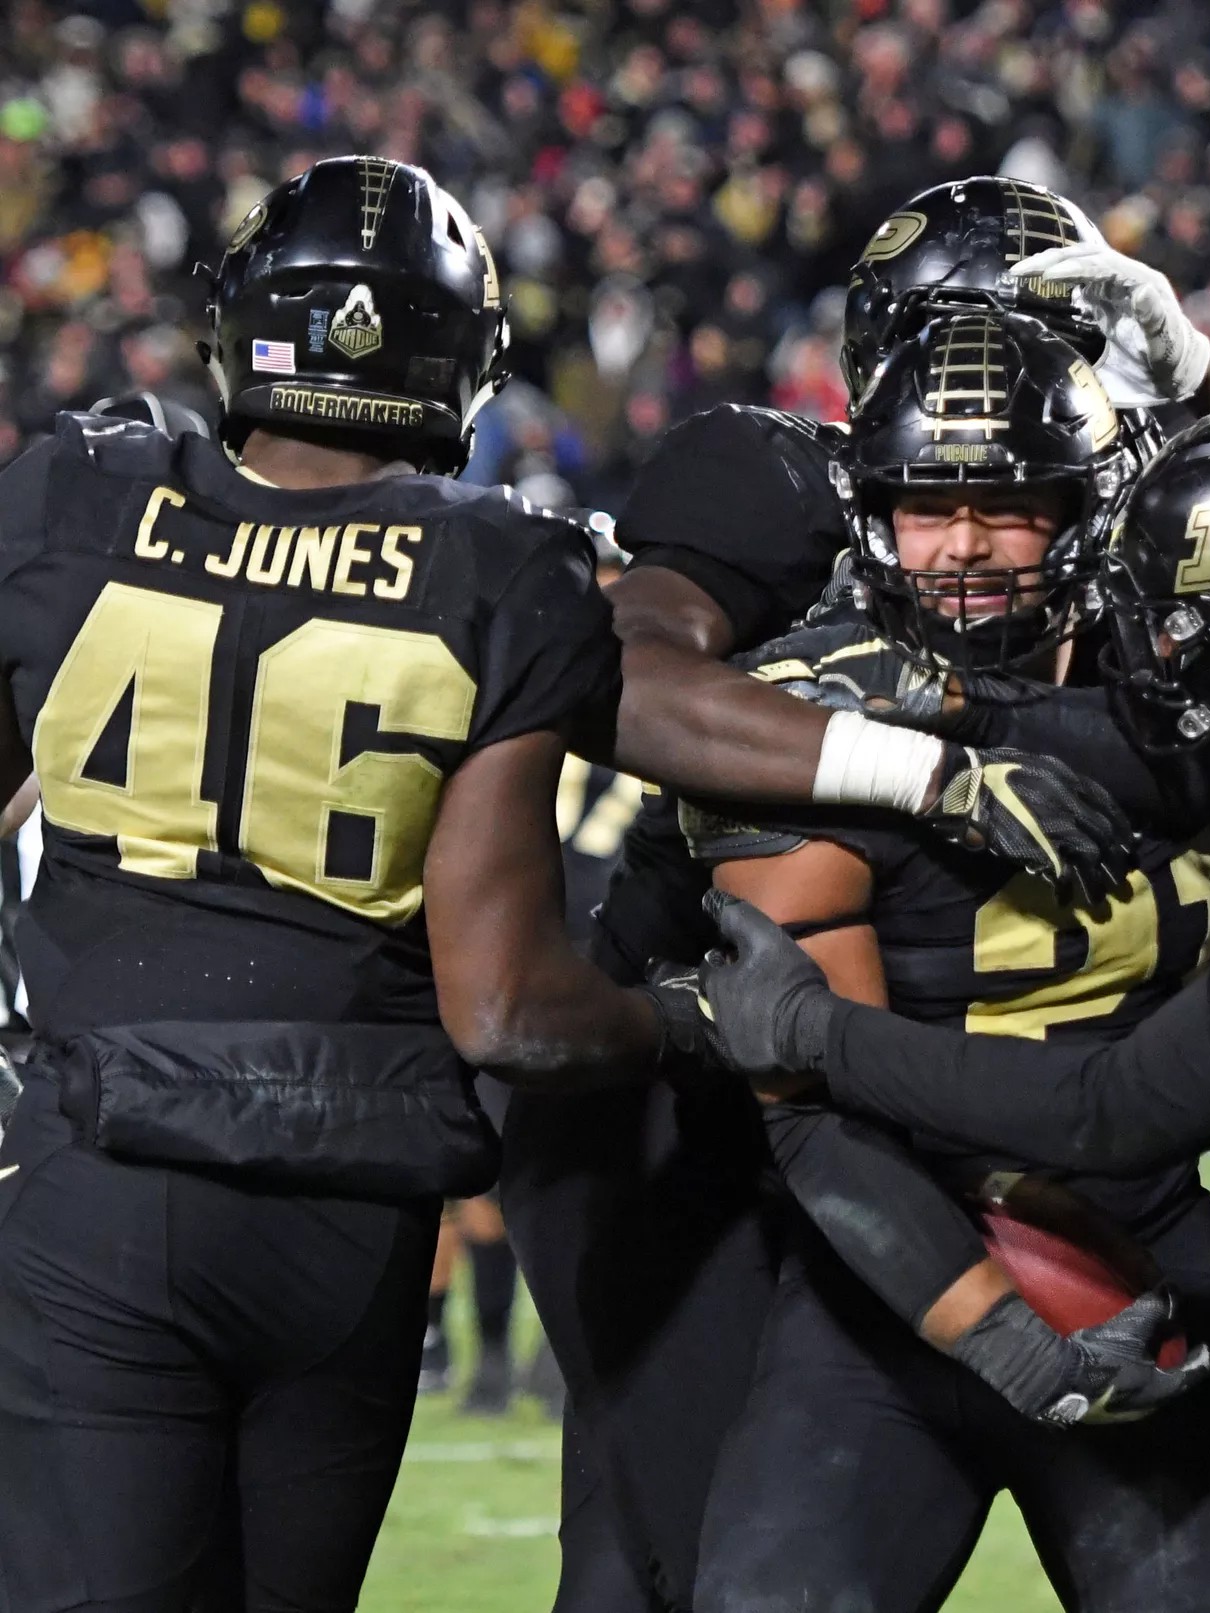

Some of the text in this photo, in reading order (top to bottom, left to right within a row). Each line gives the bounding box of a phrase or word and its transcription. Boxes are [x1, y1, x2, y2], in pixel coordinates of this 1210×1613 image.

[333, 328, 379, 351] PURDUE
[270, 387, 423, 426] BOILERMAKERS
[935, 443, 989, 462] PURDUE
[134, 485, 423, 601] C. JONES
[32, 581, 478, 928] 46
